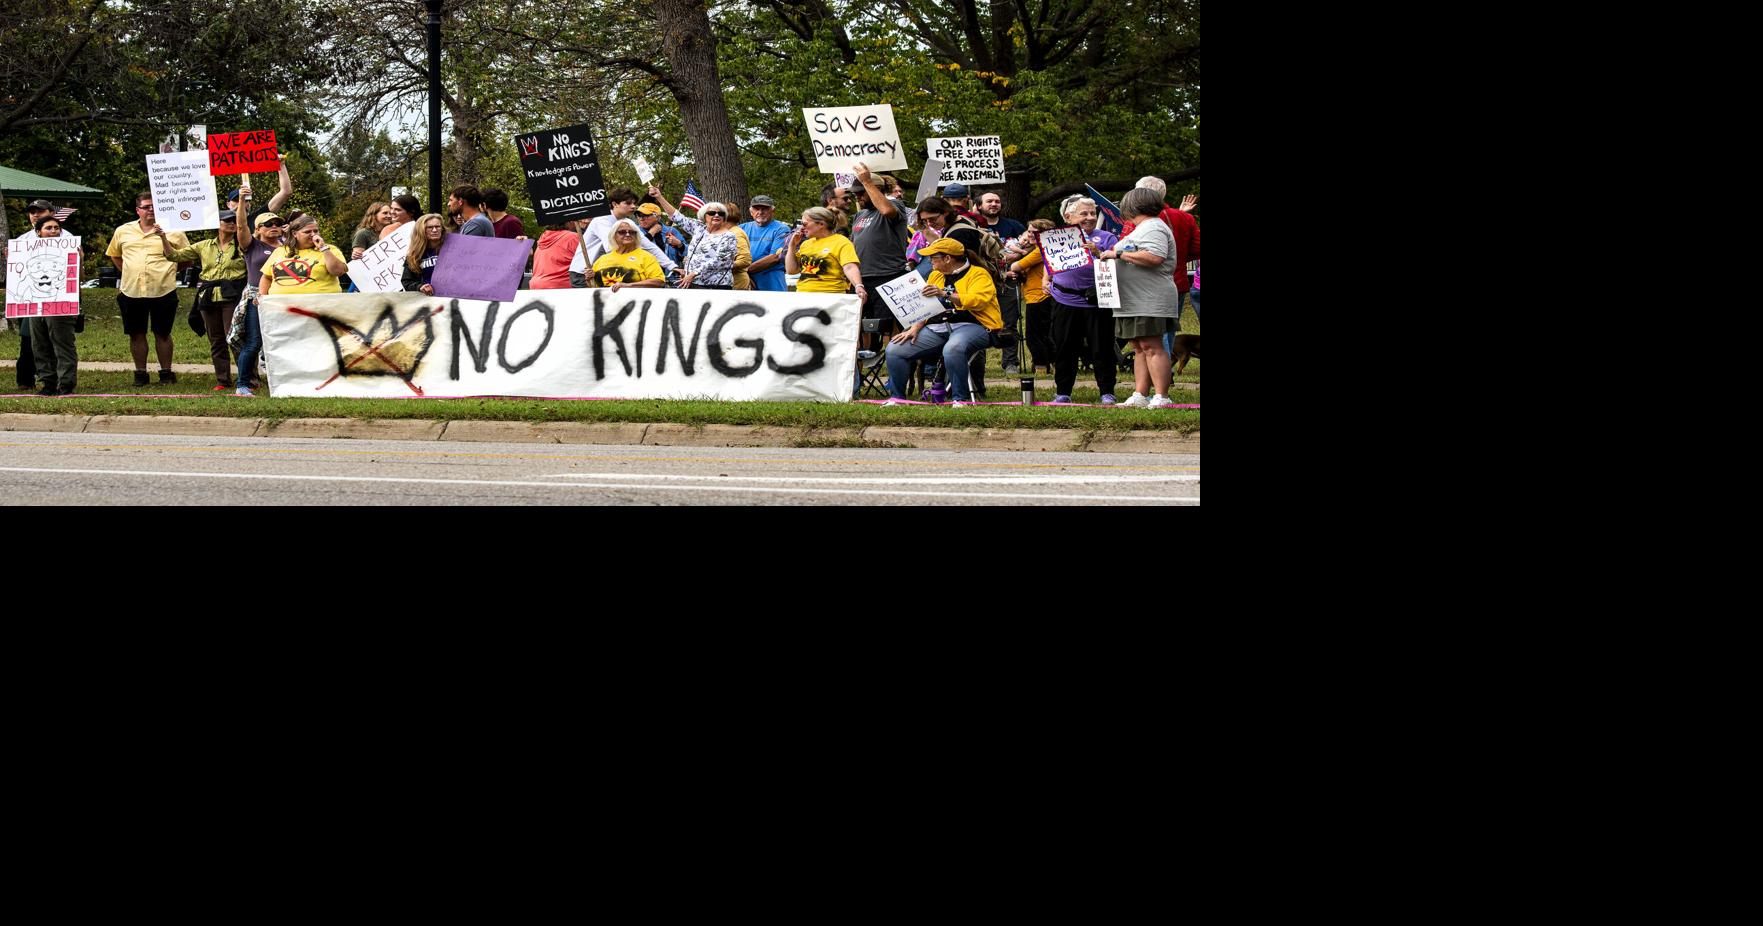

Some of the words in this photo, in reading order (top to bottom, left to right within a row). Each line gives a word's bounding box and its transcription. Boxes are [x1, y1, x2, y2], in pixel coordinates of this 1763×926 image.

[814, 113, 881, 134] Save
[212, 134, 241, 149] WE
[243, 131, 273, 145] ARE
[552, 133, 570, 146] NO
[941, 139, 963, 149] OUR
[211, 147, 278, 168] PATRIOTS
[548, 140, 590, 162] KINGS
[813, 139, 897, 159] Democracy
[936, 150, 963, 158] FREE
[966, 149, 1000, 158] SPEECH
[955, 160, 999, 169] PROCESS
[556, 175, 579, 188] NO
[939, 171, 954, 181] REE
[956, 170, 1004, 180] ASSEMBLY
[540, 189, 606, 210] DICTATORS
[12, 241, 21, 252] I
[26, 239, 54, 252] WANT
[54, 238, 78, 250] YOU
[1046, 234, 1074, 244] Think
[360, 232, 406, 271] FIRE
[1044, 246, 1064, 258] Your
[1068, 241, 1081, 251] Vot
[373, 266, 402, 291] RFK
[7, 303, 38, 317] THE
[42, 301, 78, 315] RICH
[450, 299, 554, 379] NO
[593, 290, 832, 380] KINGS
